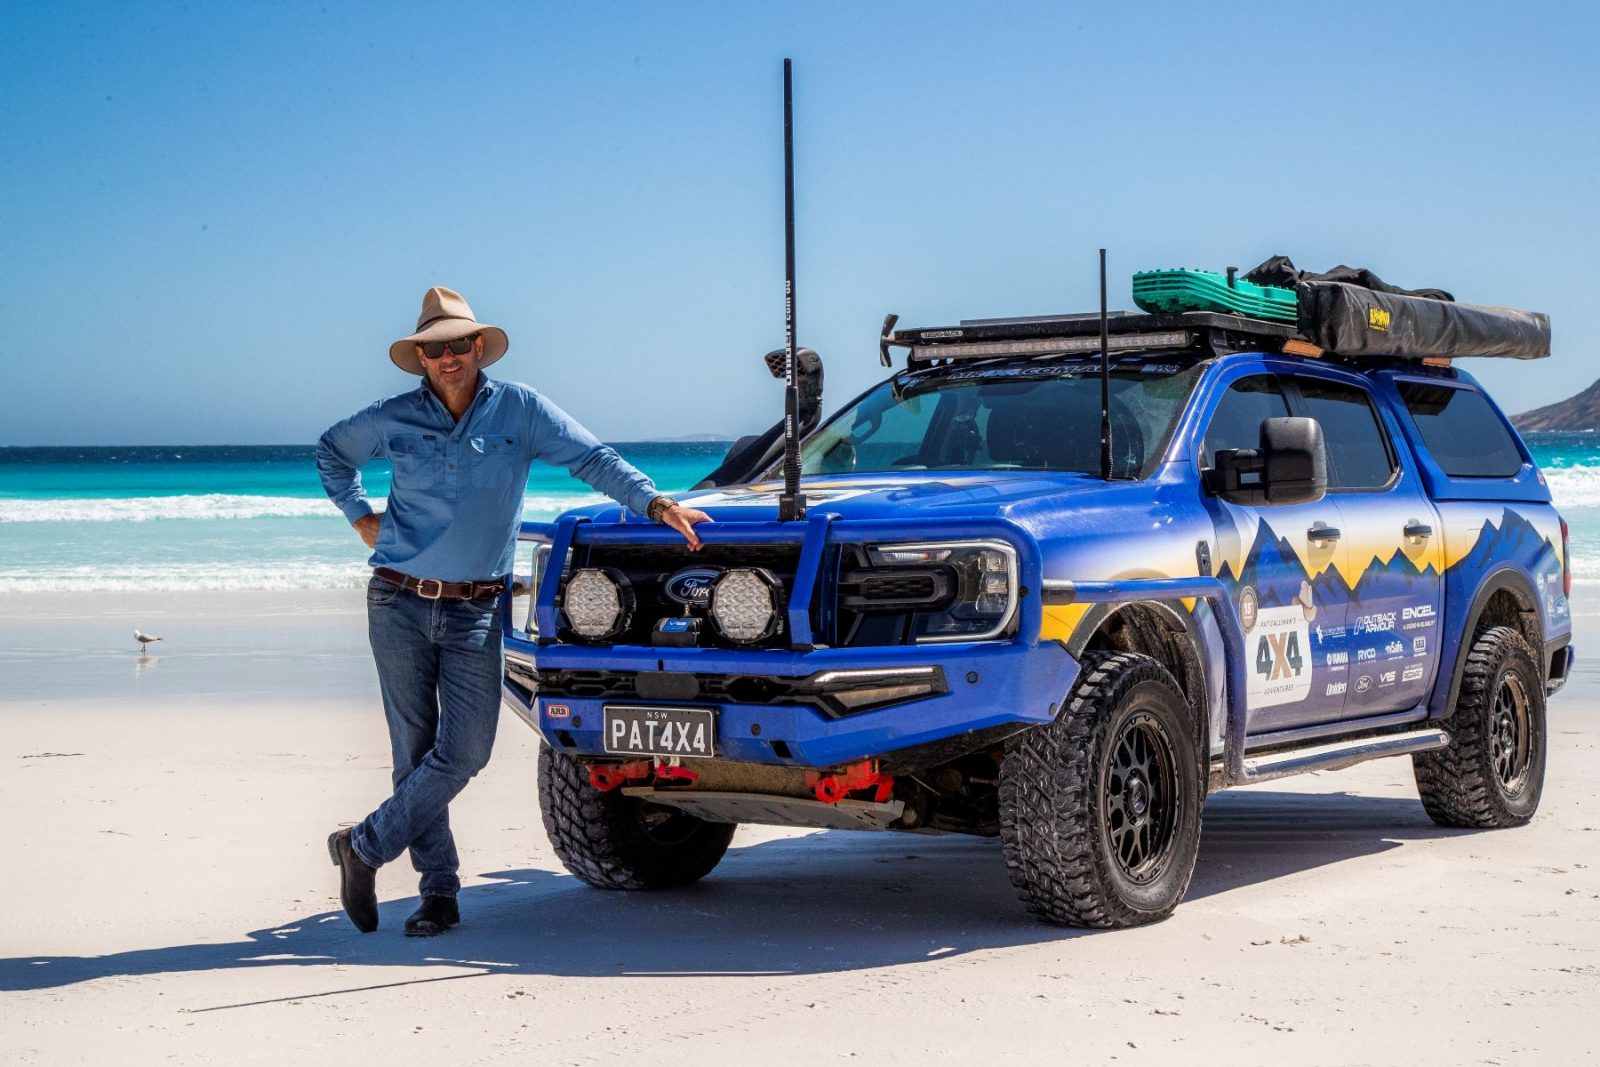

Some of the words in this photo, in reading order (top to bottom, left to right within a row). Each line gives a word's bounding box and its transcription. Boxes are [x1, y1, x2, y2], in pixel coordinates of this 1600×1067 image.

[1243, 602, 1254, 614] 15
[1402, 605, 1436, 620] ENGEL
[1364, 611, 1397, 624] OUTBACK
[1365, 621, 1395, 634] ARMOUR
[1256, 630, 1303, 681] 4X4
[1357, 647, 1376, 660] RYCO
[1326, 682, 1348, 696] Uniden
[550, 706, 567, 715] ARB
[647, 711, 668, 719] NSW
[612, 719, 706, 752] PAT4X4
